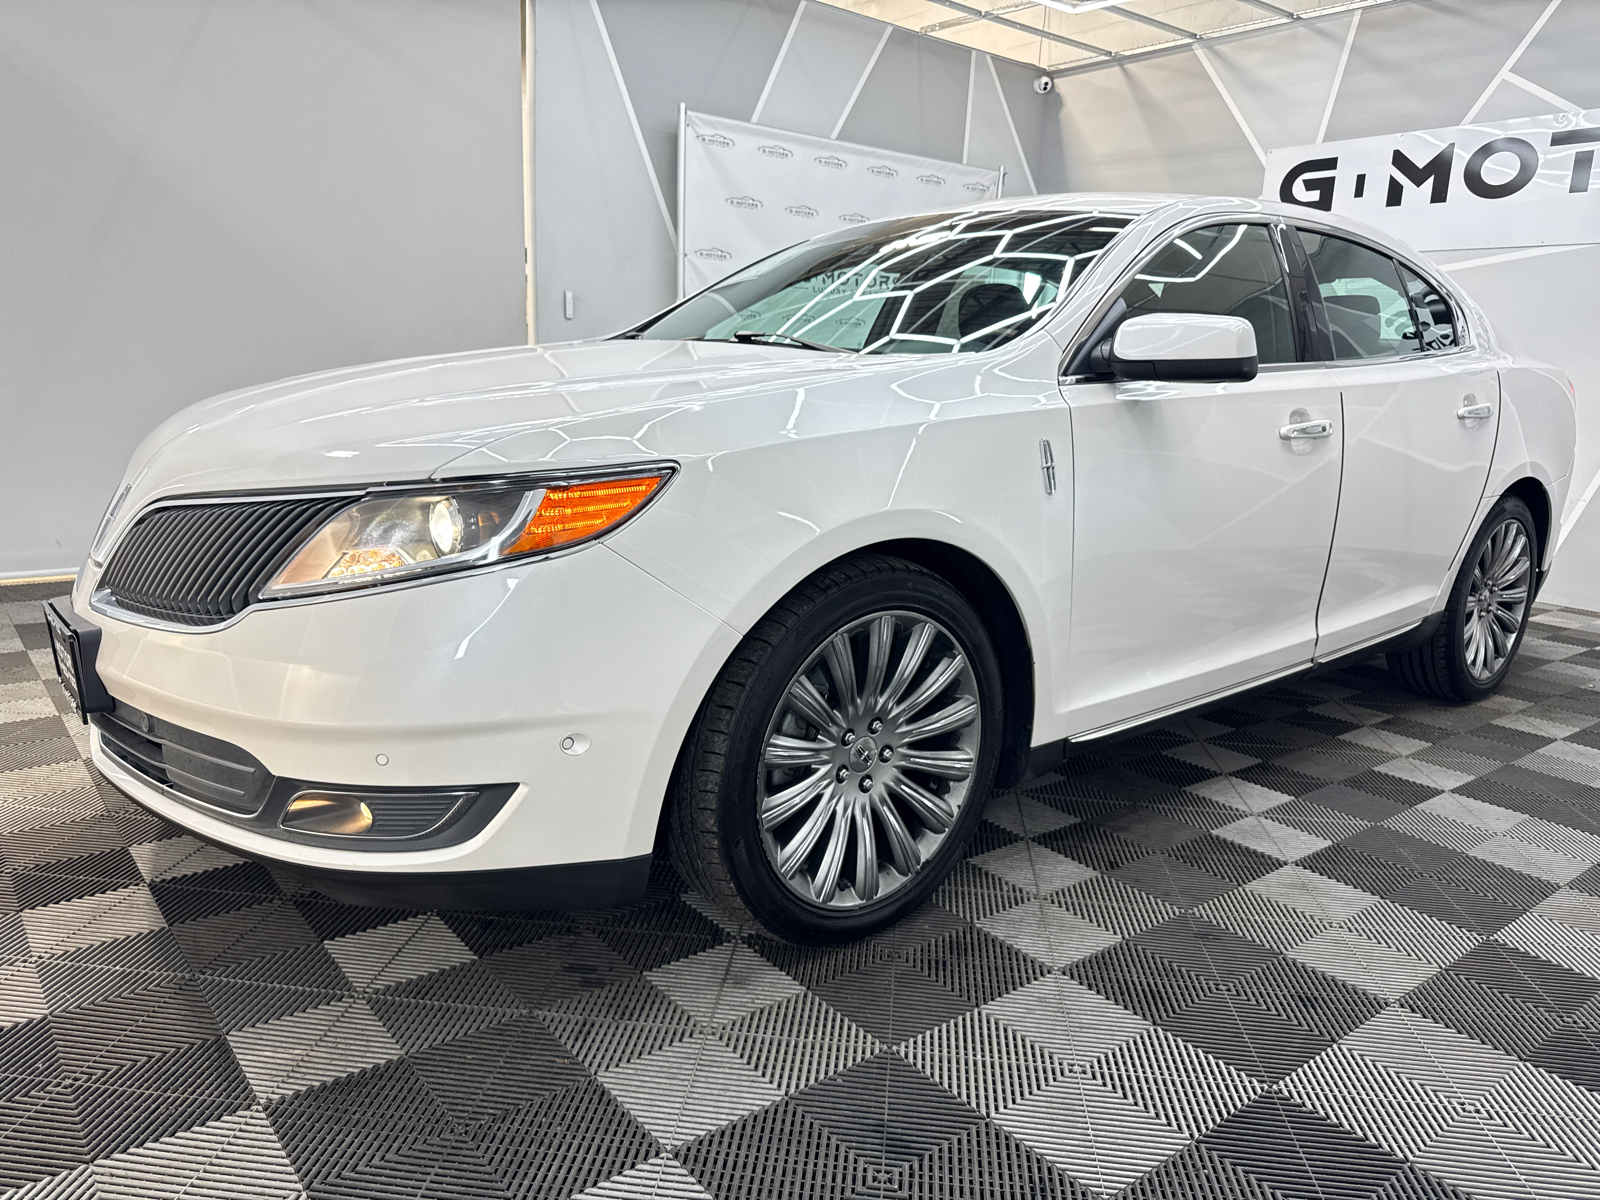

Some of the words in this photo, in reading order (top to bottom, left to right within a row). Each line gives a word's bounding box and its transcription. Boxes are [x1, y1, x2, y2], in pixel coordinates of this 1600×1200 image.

[707, 138, 730, 147] MOTORS
[767, 149, 789, 158] MOTORS
[823, 160, 843, 168] MOTORS
[875, 170, 894, 178] MOTORS
[1279, 156, 1339, 212] G
[735, 201, 758, 209] MOTORS
